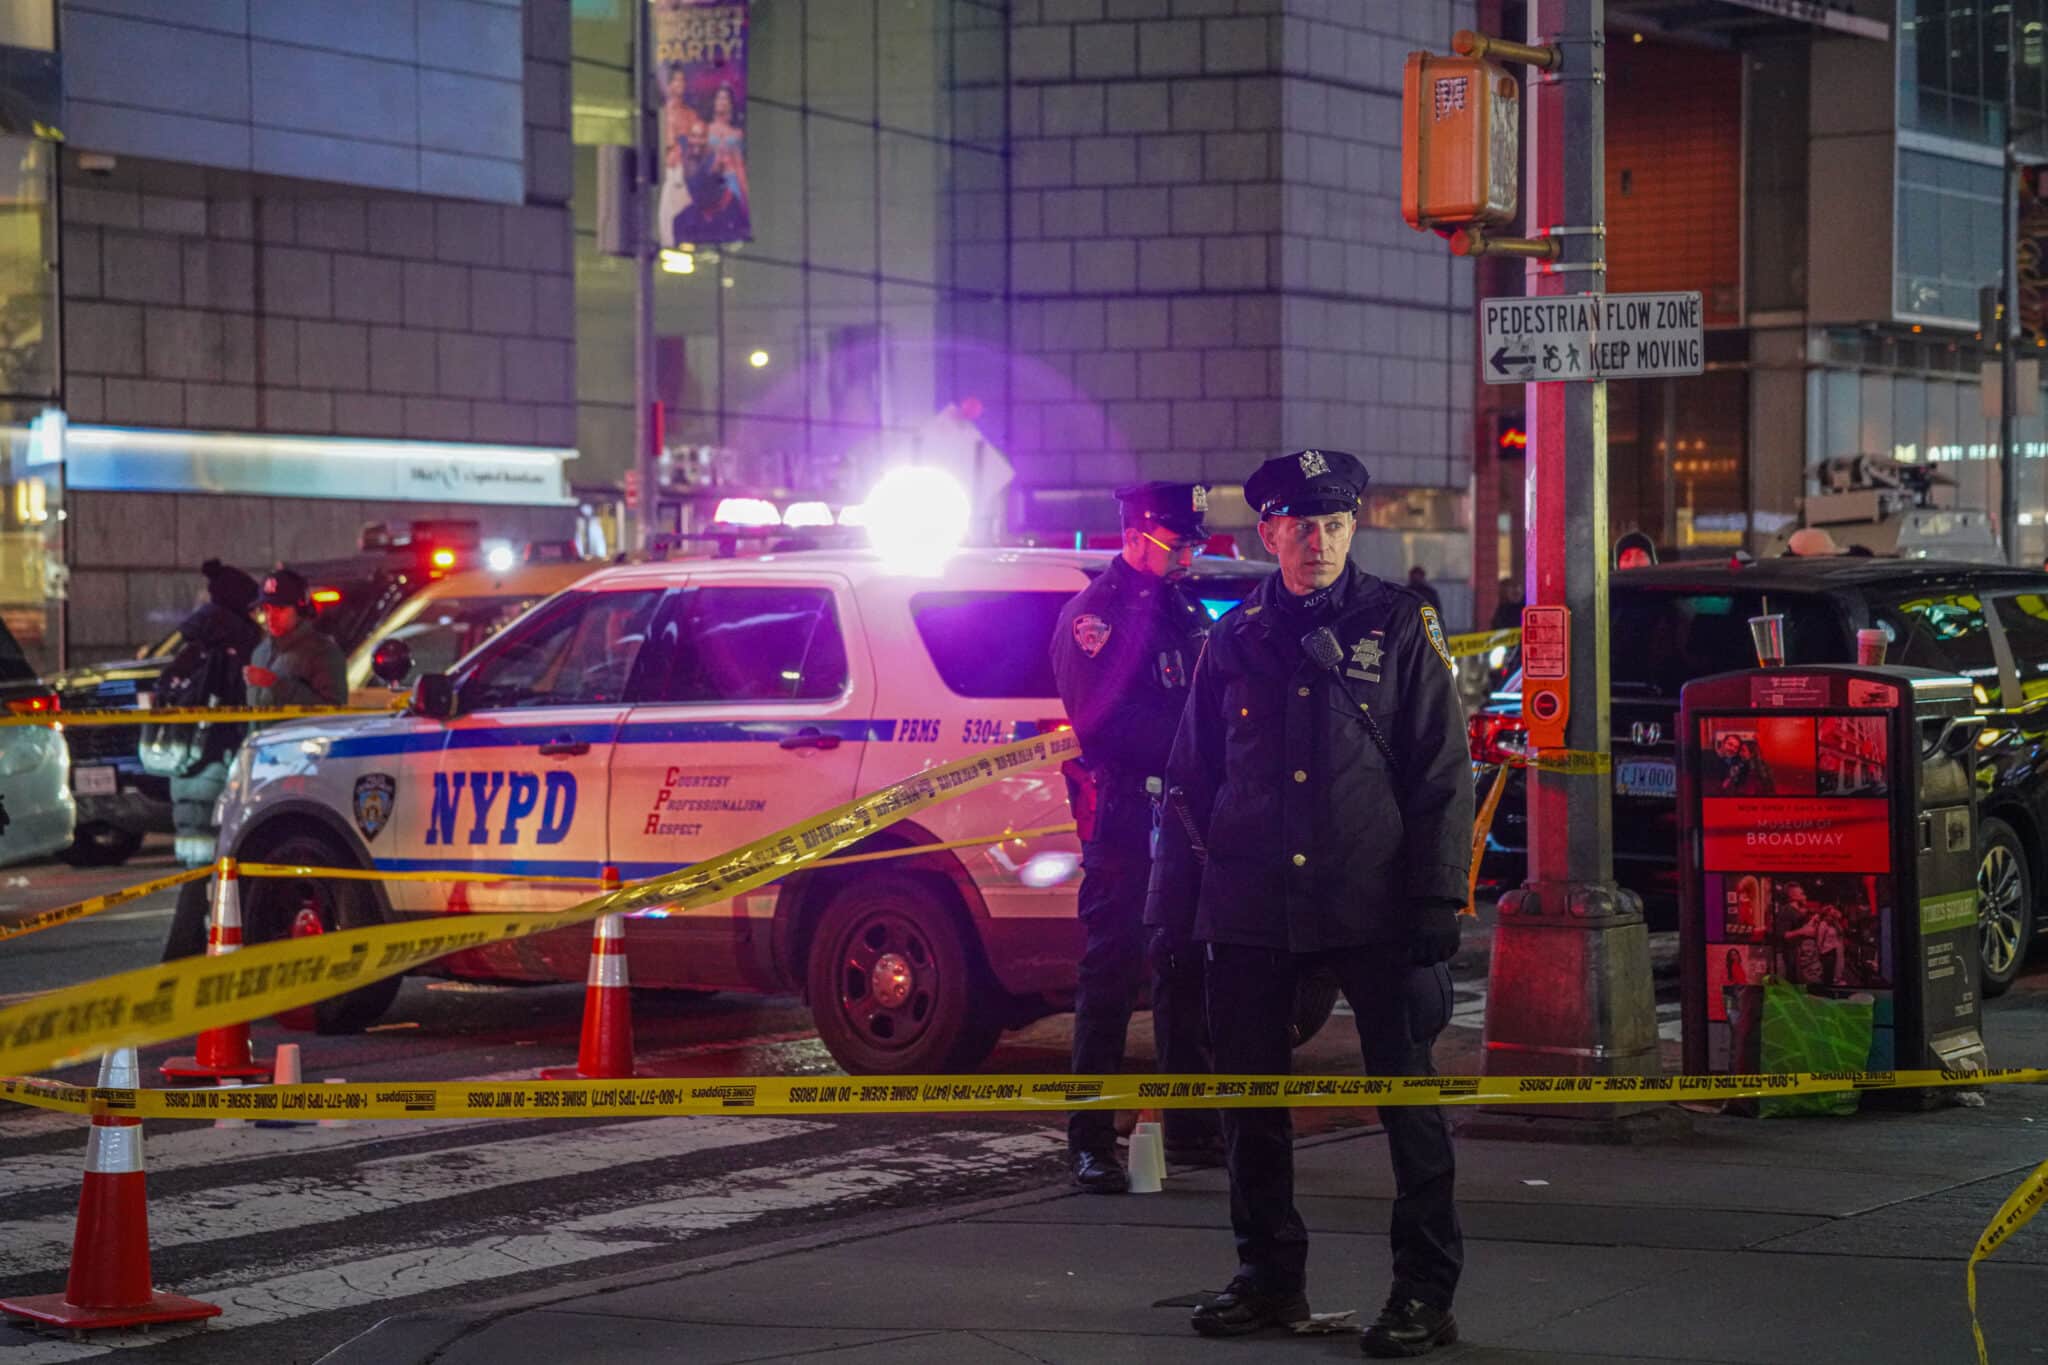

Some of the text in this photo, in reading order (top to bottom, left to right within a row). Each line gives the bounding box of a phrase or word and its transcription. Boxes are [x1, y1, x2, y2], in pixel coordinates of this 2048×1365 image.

[1487, 300, 1699, 335] PEDESTRIAN FLOW ZONE
[1589, 339, 1699, 371] KEEP MOVING
[665, 766, 731, 788] COURTESY
[426, 770, 578, 846] NYPD
[653, 789, 767, 812] PROFESSIONALISM
[644, 813, 703, 835] RESPECT
[1757, 819, 1832, 829] MUSEUM OF
[1746, 832, 1844, 846] BROADWAY
[789, 1087, 817, 1103] CROSS
[819, 1087, 837, 1102] NOT
[839, 1087, 851, 1101] DO
[860, 1087, 888, 1101] SCENE
[890, 1086, 918, 1101] CRIME
[923, 1084, 950, 1101] (8477)
[1138, 1082, 1169, 1097] CROSS
[1172, 1082, 1191, 1096] NOT
[1192, 1082, 1205, 1096] DO
[1216, 1081, 1246, 1096] SCENE
[1248, 1081, 1279, 1096] CRIME
[1284, 1080, 1315, 1096] (8477)
[165, 1092, 190, 1107] CROSS
[191, 1093, 207, 1107] NOT
[208, 1093, 219, 1107] DO
[227, 1092, 252, 1108] SCENE
[253, 1093, 278, 1109] CRIME
[281, 1093, 306, 1110] (8477)
[467, 1092, 495, 1107] CROSS
[496, 1092, 512, 1108] NOT
[513, 1092, 525, 1107] DO
[534, 1091, 560, 1107] SCENE
[562, 1090, 587, 1106] CRIME
[591, 1089, 617, 1106] (8477)
